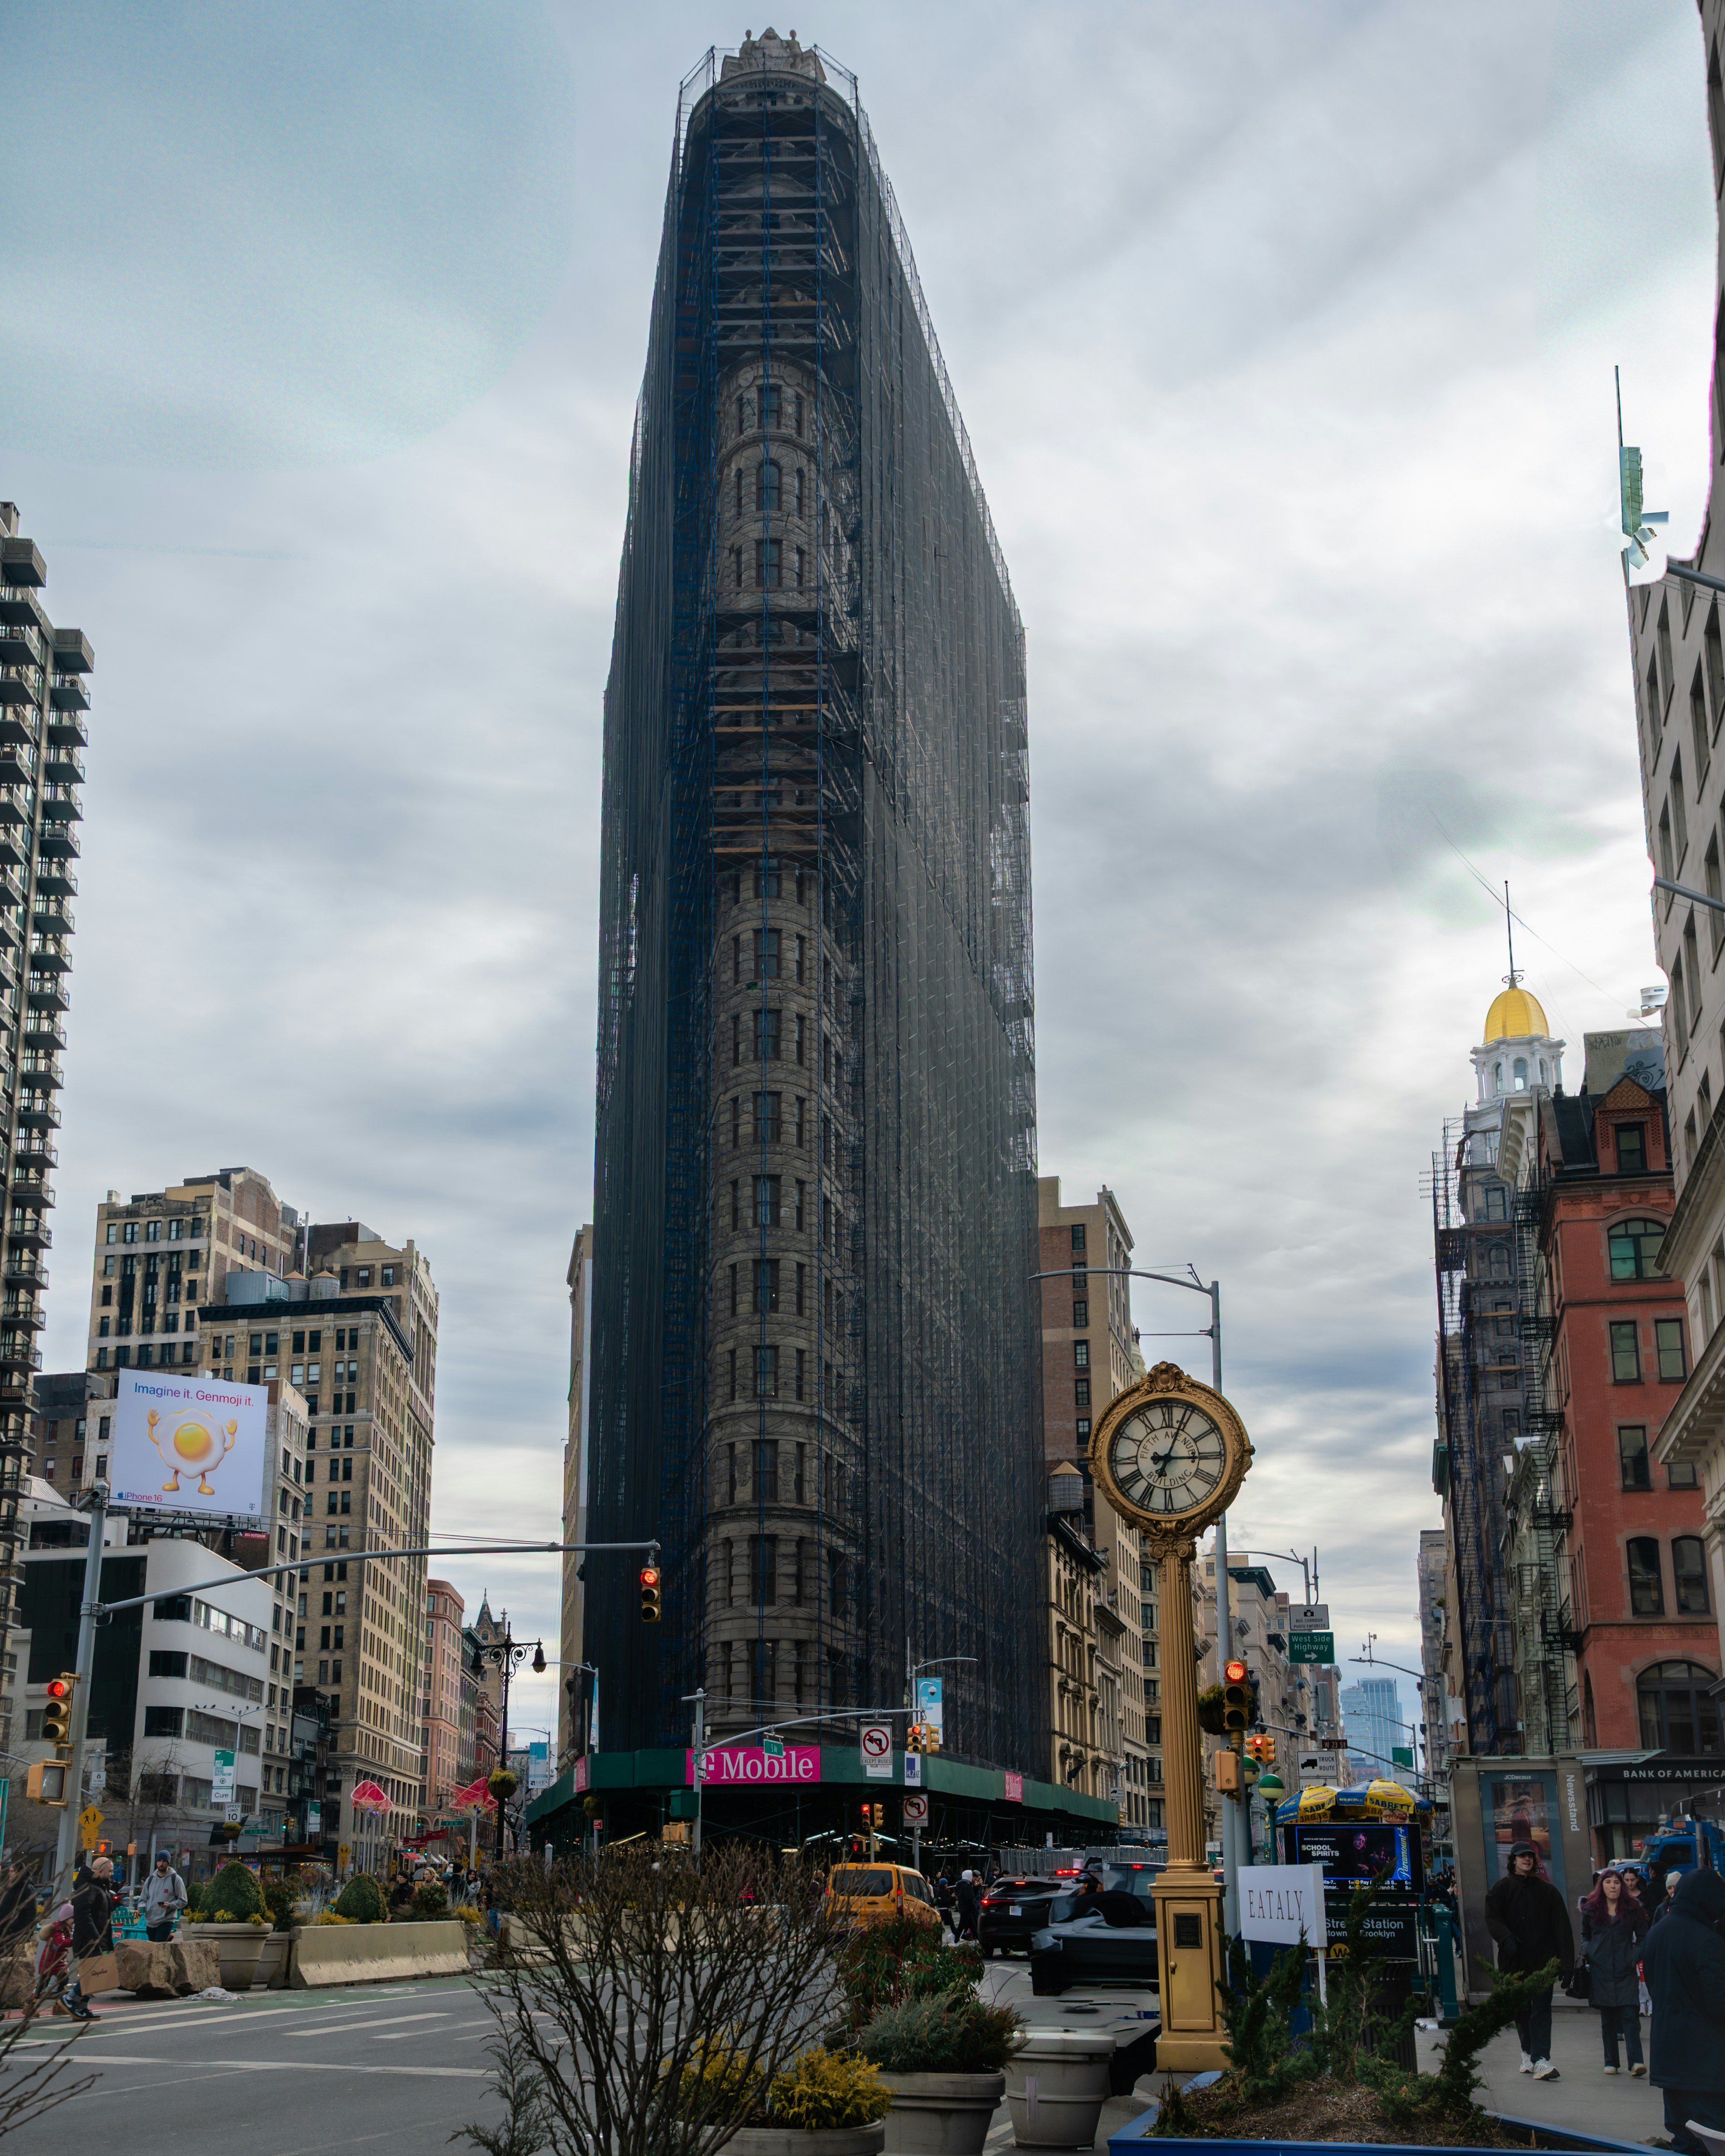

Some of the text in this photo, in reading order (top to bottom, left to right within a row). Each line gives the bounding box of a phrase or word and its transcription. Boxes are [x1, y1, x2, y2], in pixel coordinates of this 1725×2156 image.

[135, 1382, 254, 1406] Imagine it. Genmoji it.
[1140, 1431, 1196, 1459] FIFTH AVENUE
[124, 1492, 152, 1502] iPhone
[1294, 1643, 1328, 1651] Highway
[720, 1751, 813, 1779] Mobile
[1369, 1797, 1411, 1813] SABRETT
[1566, 1774, 1580, 1831] Newsstand
[1248, 1890, 1303, 1921] EATALY
[1325, 1919, 1404, 1929] Stre Station
[1333, 1948, 1348, 1957] W
